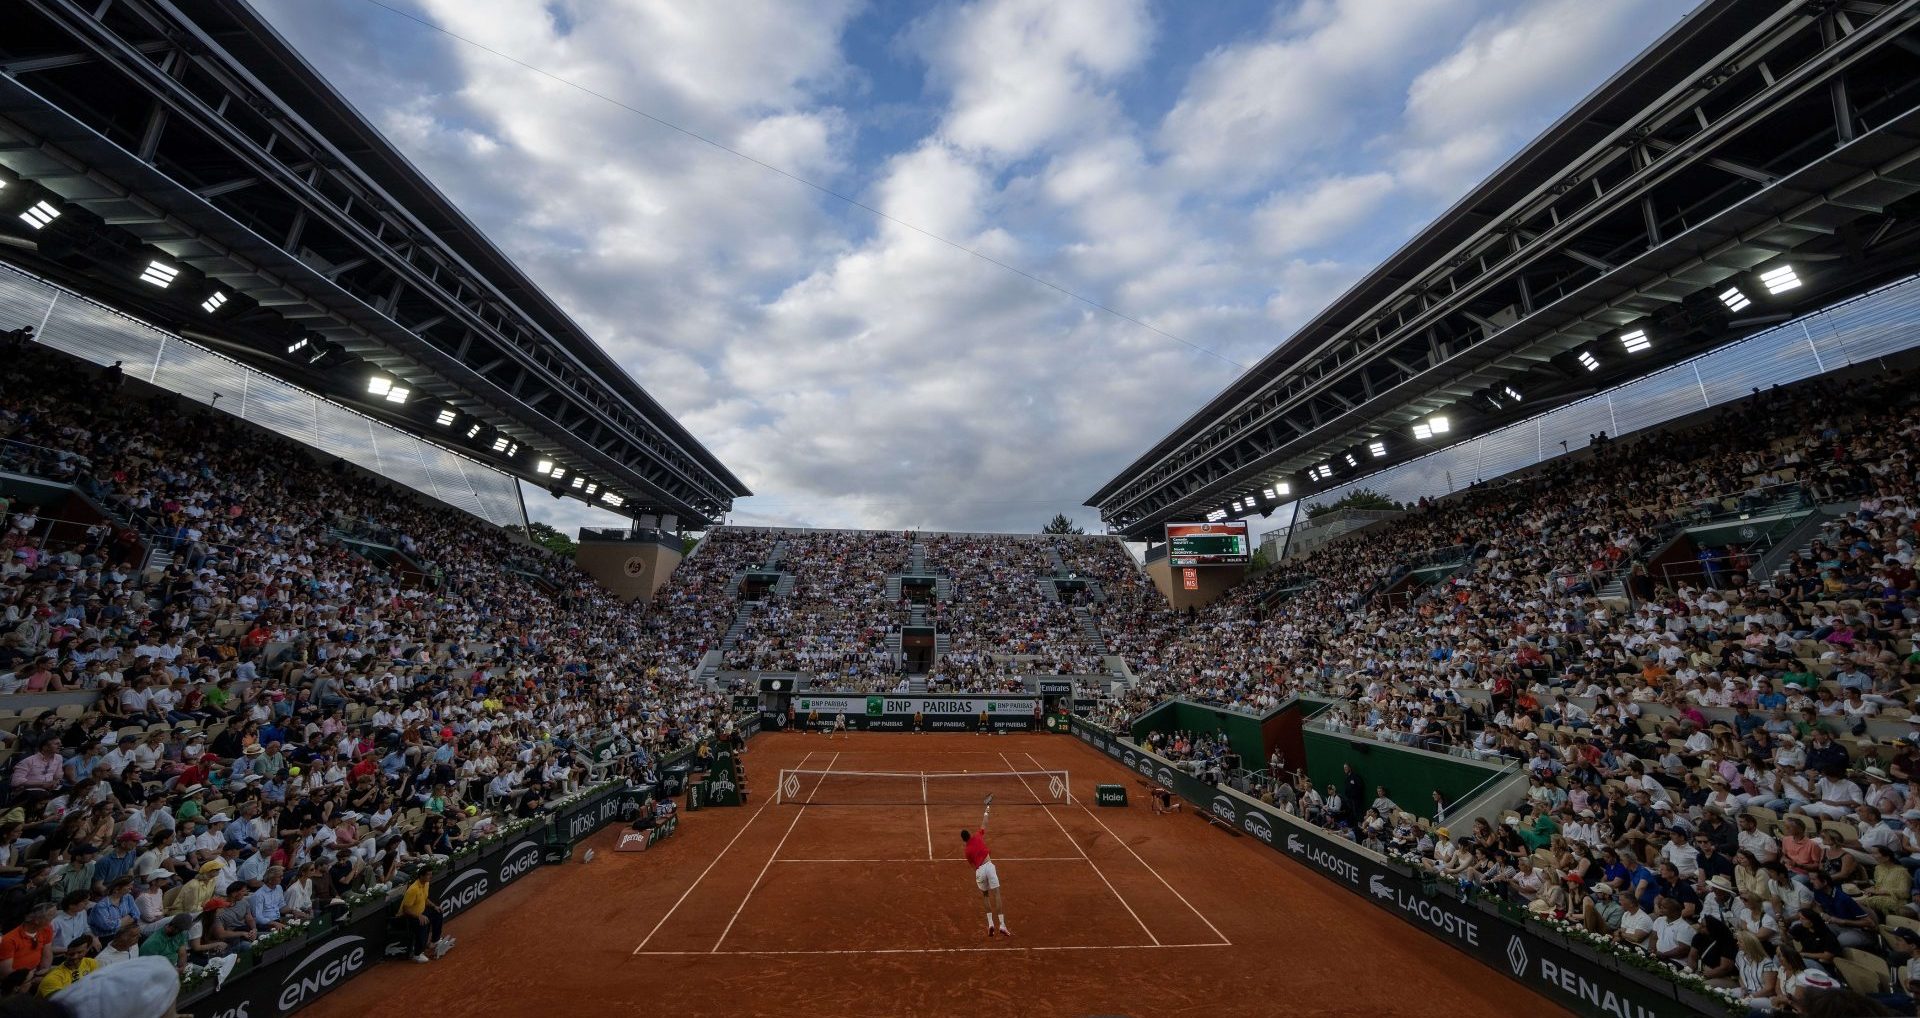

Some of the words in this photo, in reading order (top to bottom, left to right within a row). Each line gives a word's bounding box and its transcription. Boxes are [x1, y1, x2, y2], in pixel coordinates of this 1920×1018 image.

[1041, 684, 1070, 692] Emirates
[887, 701, 912, 712] BNP
[922, 701, 972, 712] PARIBAS
[1102, 793, 1124, 801] Haier
[569, 810, 596, 840] Infosys
[1306, 843, 1360, 885] LACOSTE
[1398, 888, 1480, 947] LACOSTE
